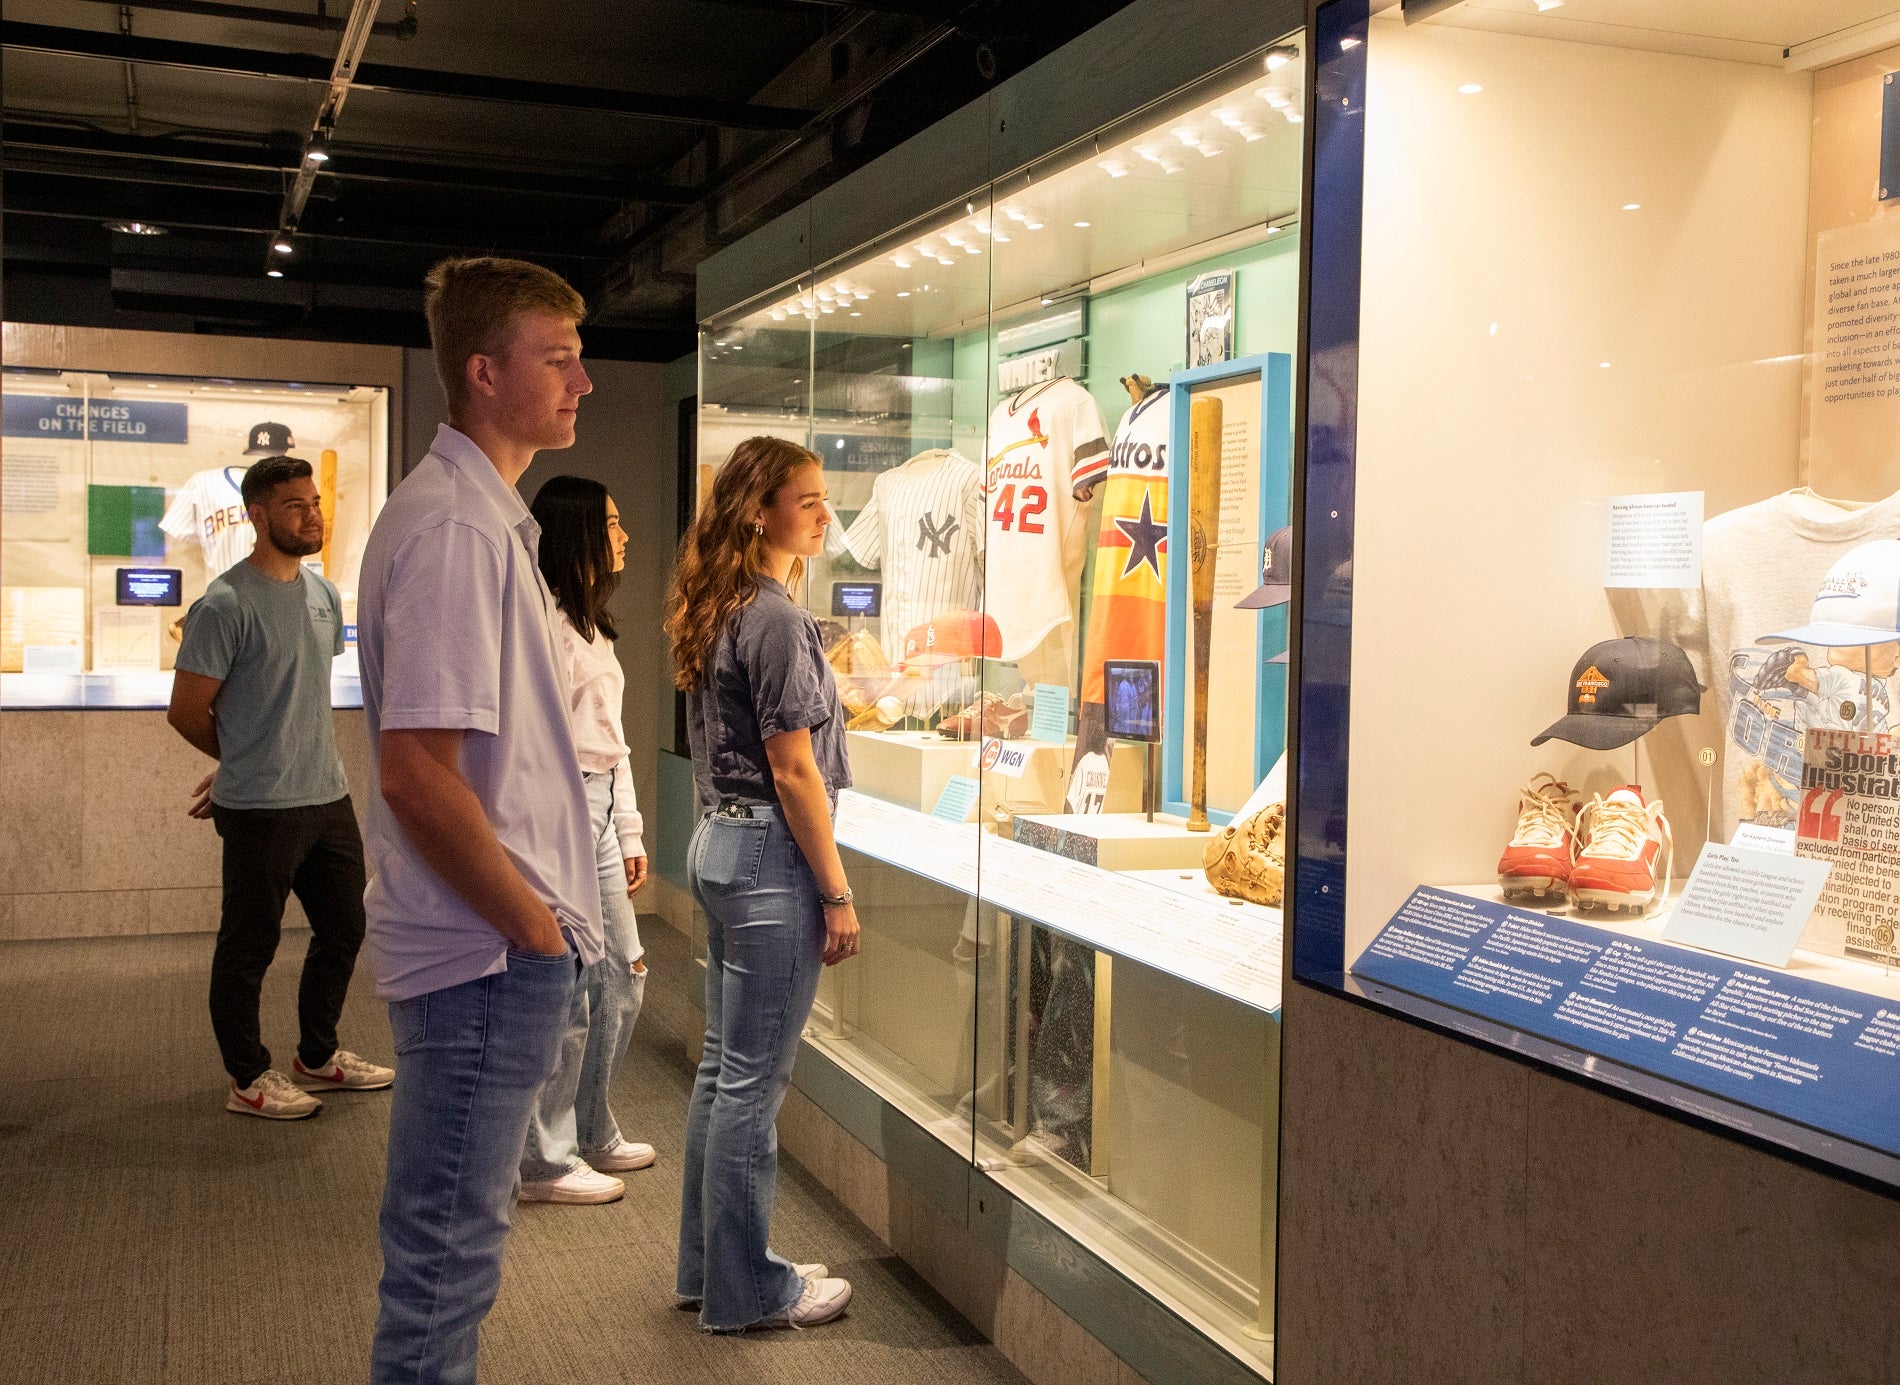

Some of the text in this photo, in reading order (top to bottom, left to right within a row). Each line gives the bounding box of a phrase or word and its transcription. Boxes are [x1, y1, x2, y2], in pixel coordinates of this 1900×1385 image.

[1830, 251, 1900, 271] Since the late 1980
[1829, 276, 1849, 286] taken
[1857, 270, 1877, 280] much
[1879, 268, 1900, 278] larger
[1828, 289, 1852, 303] global
[1853, 286, 1868, 296] and
[1869, 284, 1890, 294] more
[1828, 305, 1855, 315] diverse
[1857, 302, 1869, 310] fan
[1871, 299, 1890, 308] base.
[1827, 316, 1864, 332] promoted
[1826, 350, 1841, 358] into
[1842, 347, 1851, 356] all
[1852, 345, 1881, 355] aspects
[1882, 341, 1891, 351] of
[1825, 357, 1893, 374] marketing towards
[1824, 371, 1900, 390] just under half of big
[1824, 390, 1875, 403] opportunities
[1887, 386, 1900, 398] pla
[56, 404, 130, 420] CHANGES
[39, 417, 147, 435] ON THE FIELD
[992, 483, 1048, 535] 42
[916, 511, 960, 559] NY
[347, 628, 358, 637] D
[1842, 704, 1850, 717] 05
[1809, 729, 1893, 756] TITLE
[1000, 749, 1026, 768] WGN
[1702, 751, 1713, 763] 01
[1083, 793, 1104, 815] 17
[1847, 798, 1895, 815] No person
[1845, 811, 1860, 823] the
[1862, 813, 1893, 828] United
[1843, 823, 1900, 841] shall, on the
[1842, 835, 1868, 849] basis
[1870, 839, 1881, 850] of
[1797, 841, 1839, 856] excluded
[1840, 847, 1861, 860] from
[1862, 852, 1900, 867] participa
[1760, 871, 1778, 880] League
[1789, 877, 1805, 885] school
[1859, 861, 1875, 874] the
[1876, 866, 1900, 879] bene
[1753, 879, 1765, 887] girls
[1765, 882, 1789, 891] encounter
[1834, 871, 1880, 888] subjected
[1882, 879, 1892, 890] to
[1824, 881, 1860, 897] ination
[1862, 889, 1892, 903] under
[1819, 892, 1899, 916] tion program or
[1693, 910, 1715, 920] obstacles
[1732, 919, 1750, 927] chance
[1734, 911, 1756, 919] baseball
[1765, 918, 1784, 926] endure
[1828, 906, 1872, 927] receiving
[1877, 929, 1889, 943] 06
